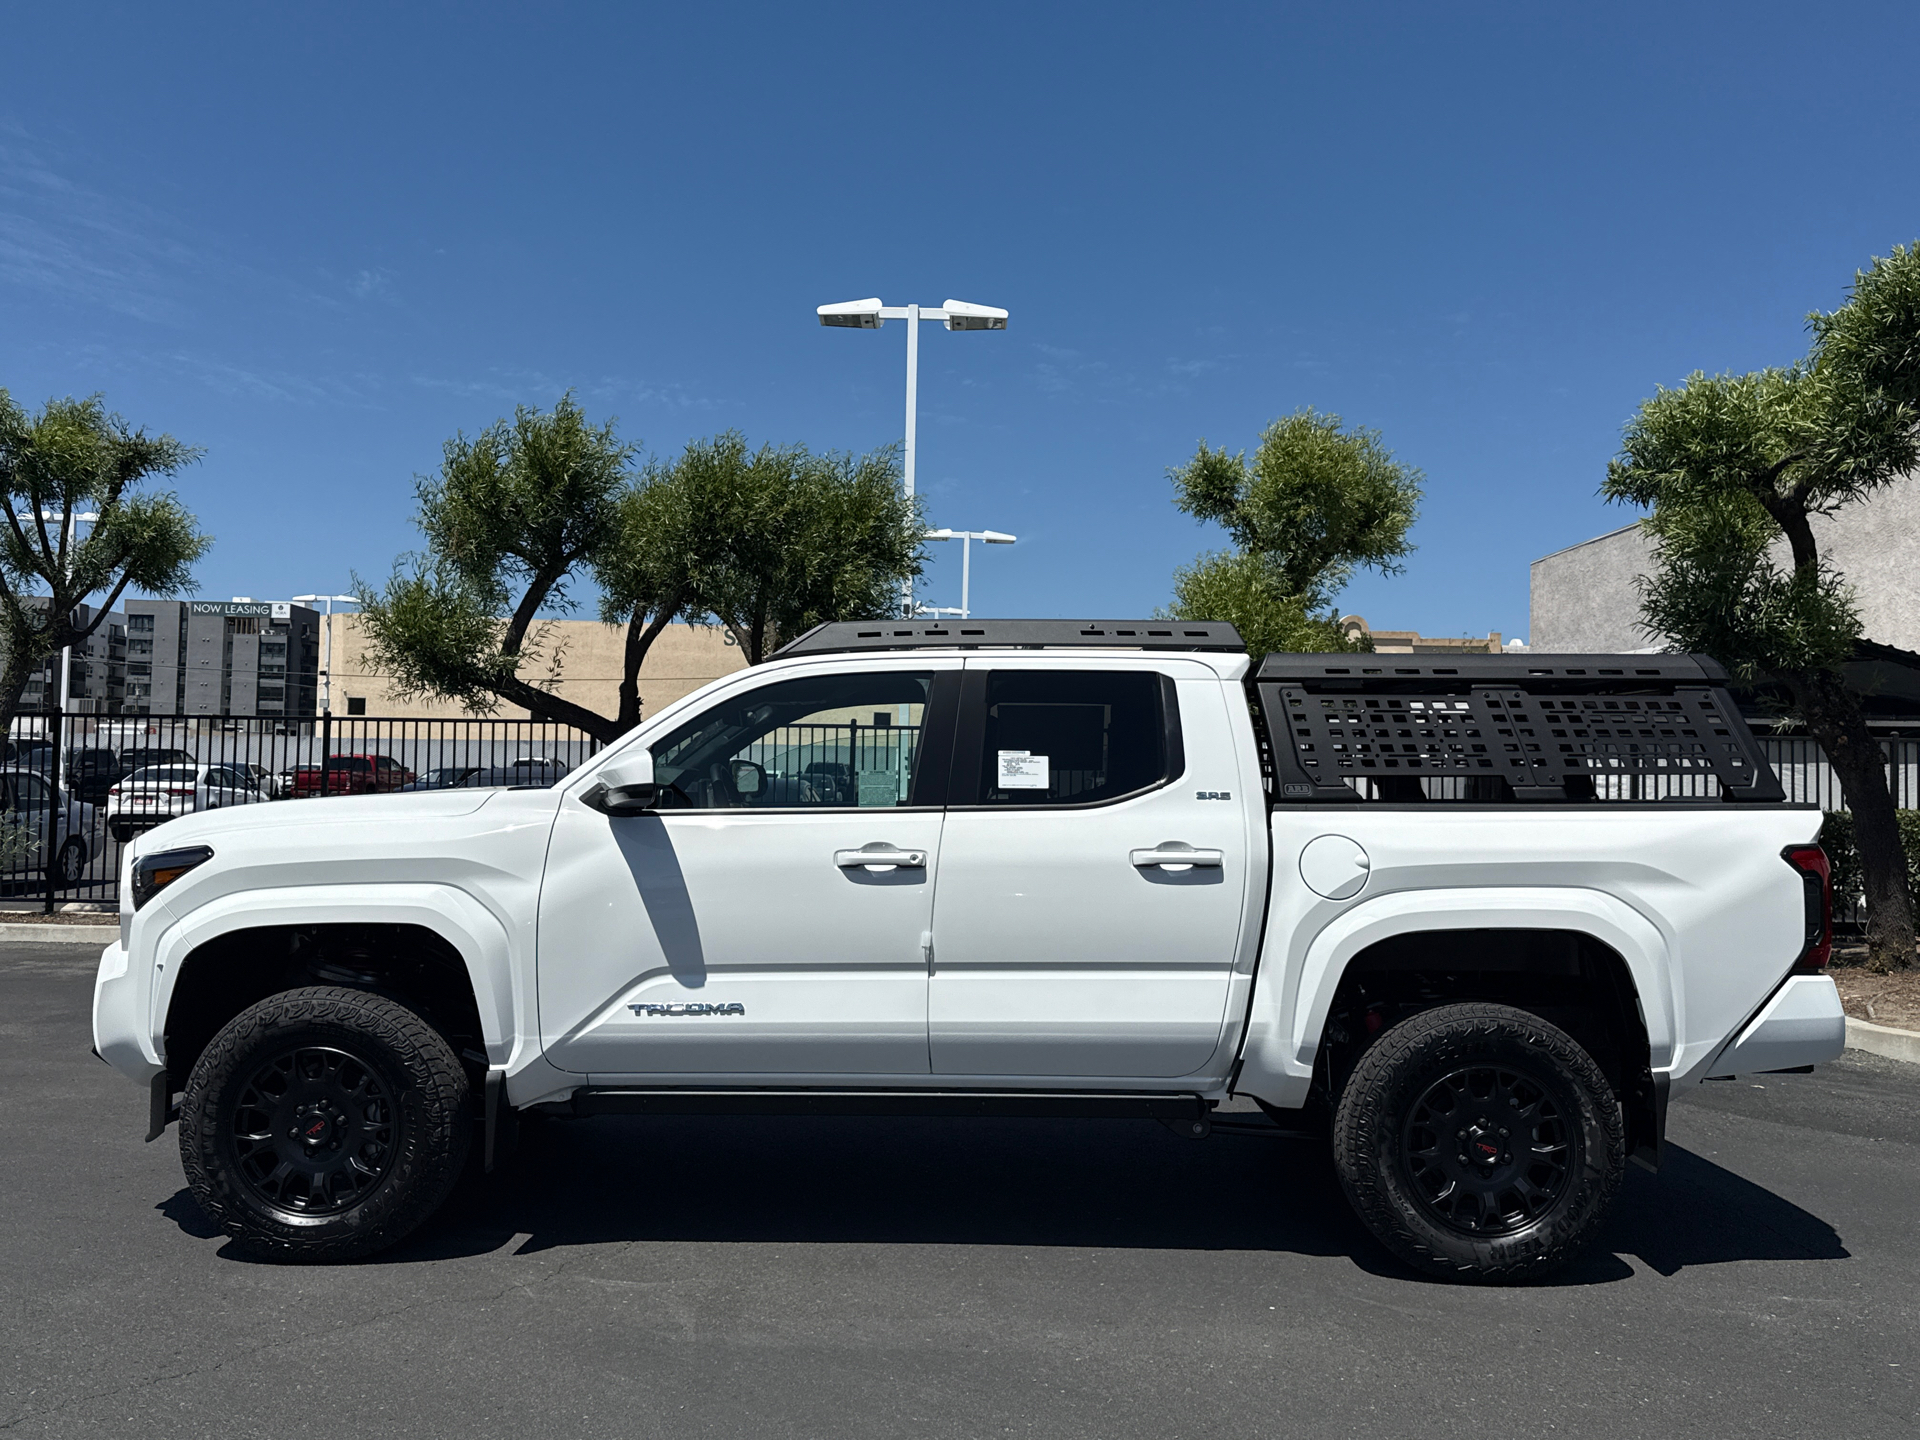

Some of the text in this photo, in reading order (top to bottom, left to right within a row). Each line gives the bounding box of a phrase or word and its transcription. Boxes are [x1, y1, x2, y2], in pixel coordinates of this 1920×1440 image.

[193, 603, 270, 615] NOW LEASING
[723, 628, 741, 646] S
[1287, 785, 1309, 793] ARB
[627, 1002, 745, 1017] TACOMA
[1476, 1142, 1498, 1154] TRD
